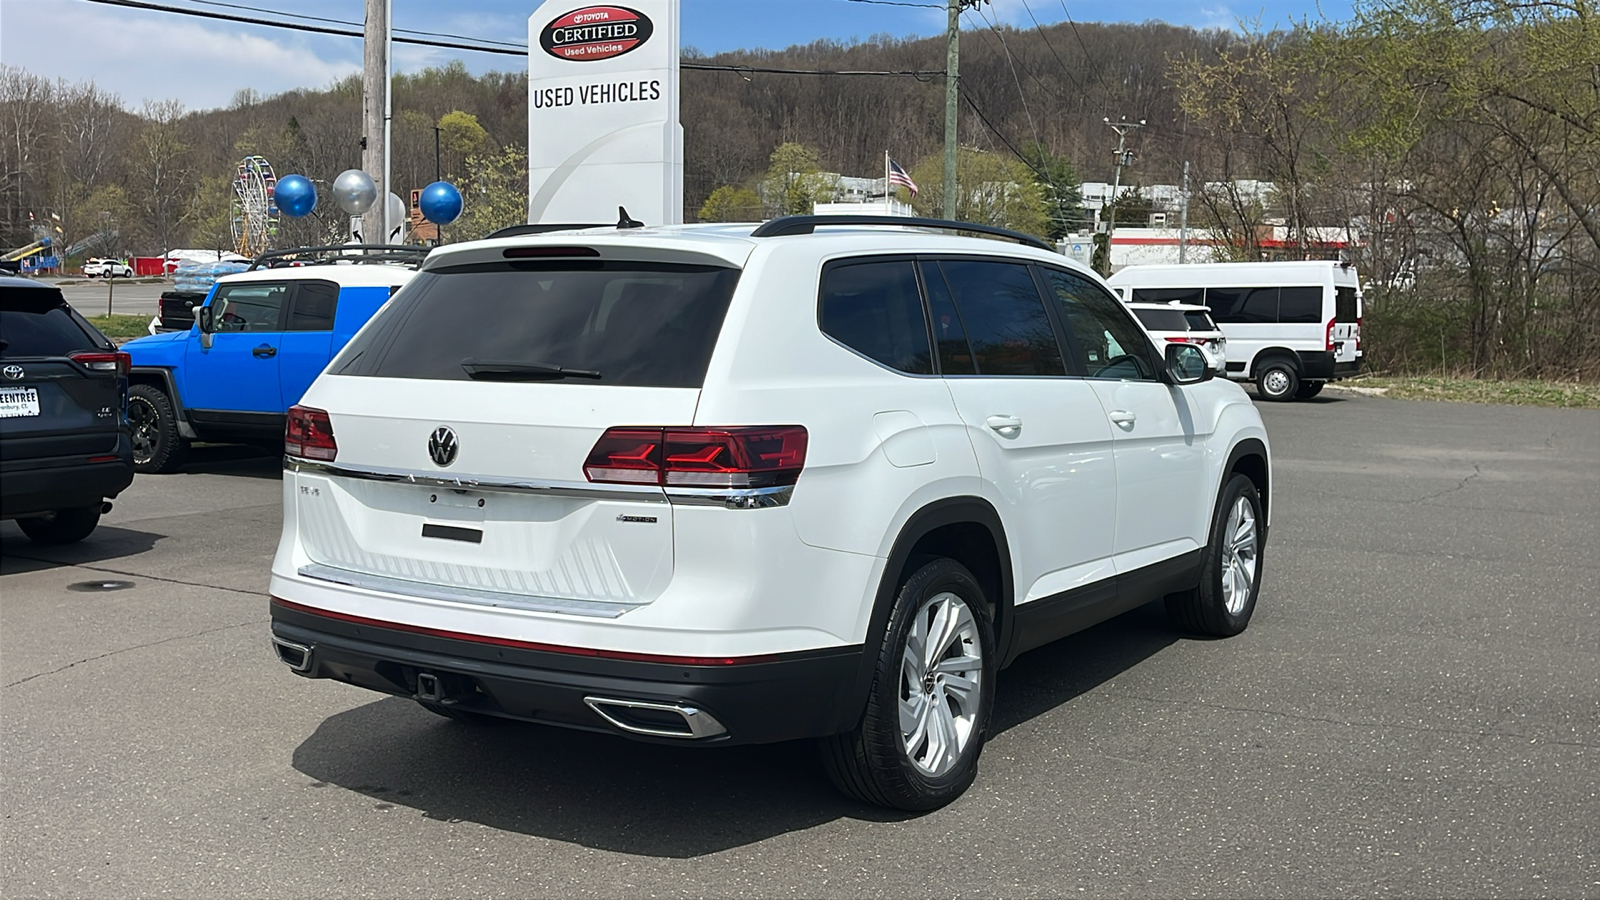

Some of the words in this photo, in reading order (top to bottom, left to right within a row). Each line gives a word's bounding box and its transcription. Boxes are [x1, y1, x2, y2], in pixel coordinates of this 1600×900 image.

[583, 12, 609, 22] TOYOTA
[552, 24, 638, 44] CERTIFIED
[564, 47, 585, 56] Used
[586, 44, 623, 54] Vehicles
[534, 87, 574, 109] USED
[579, 80, 661, 104] VEHICLES
